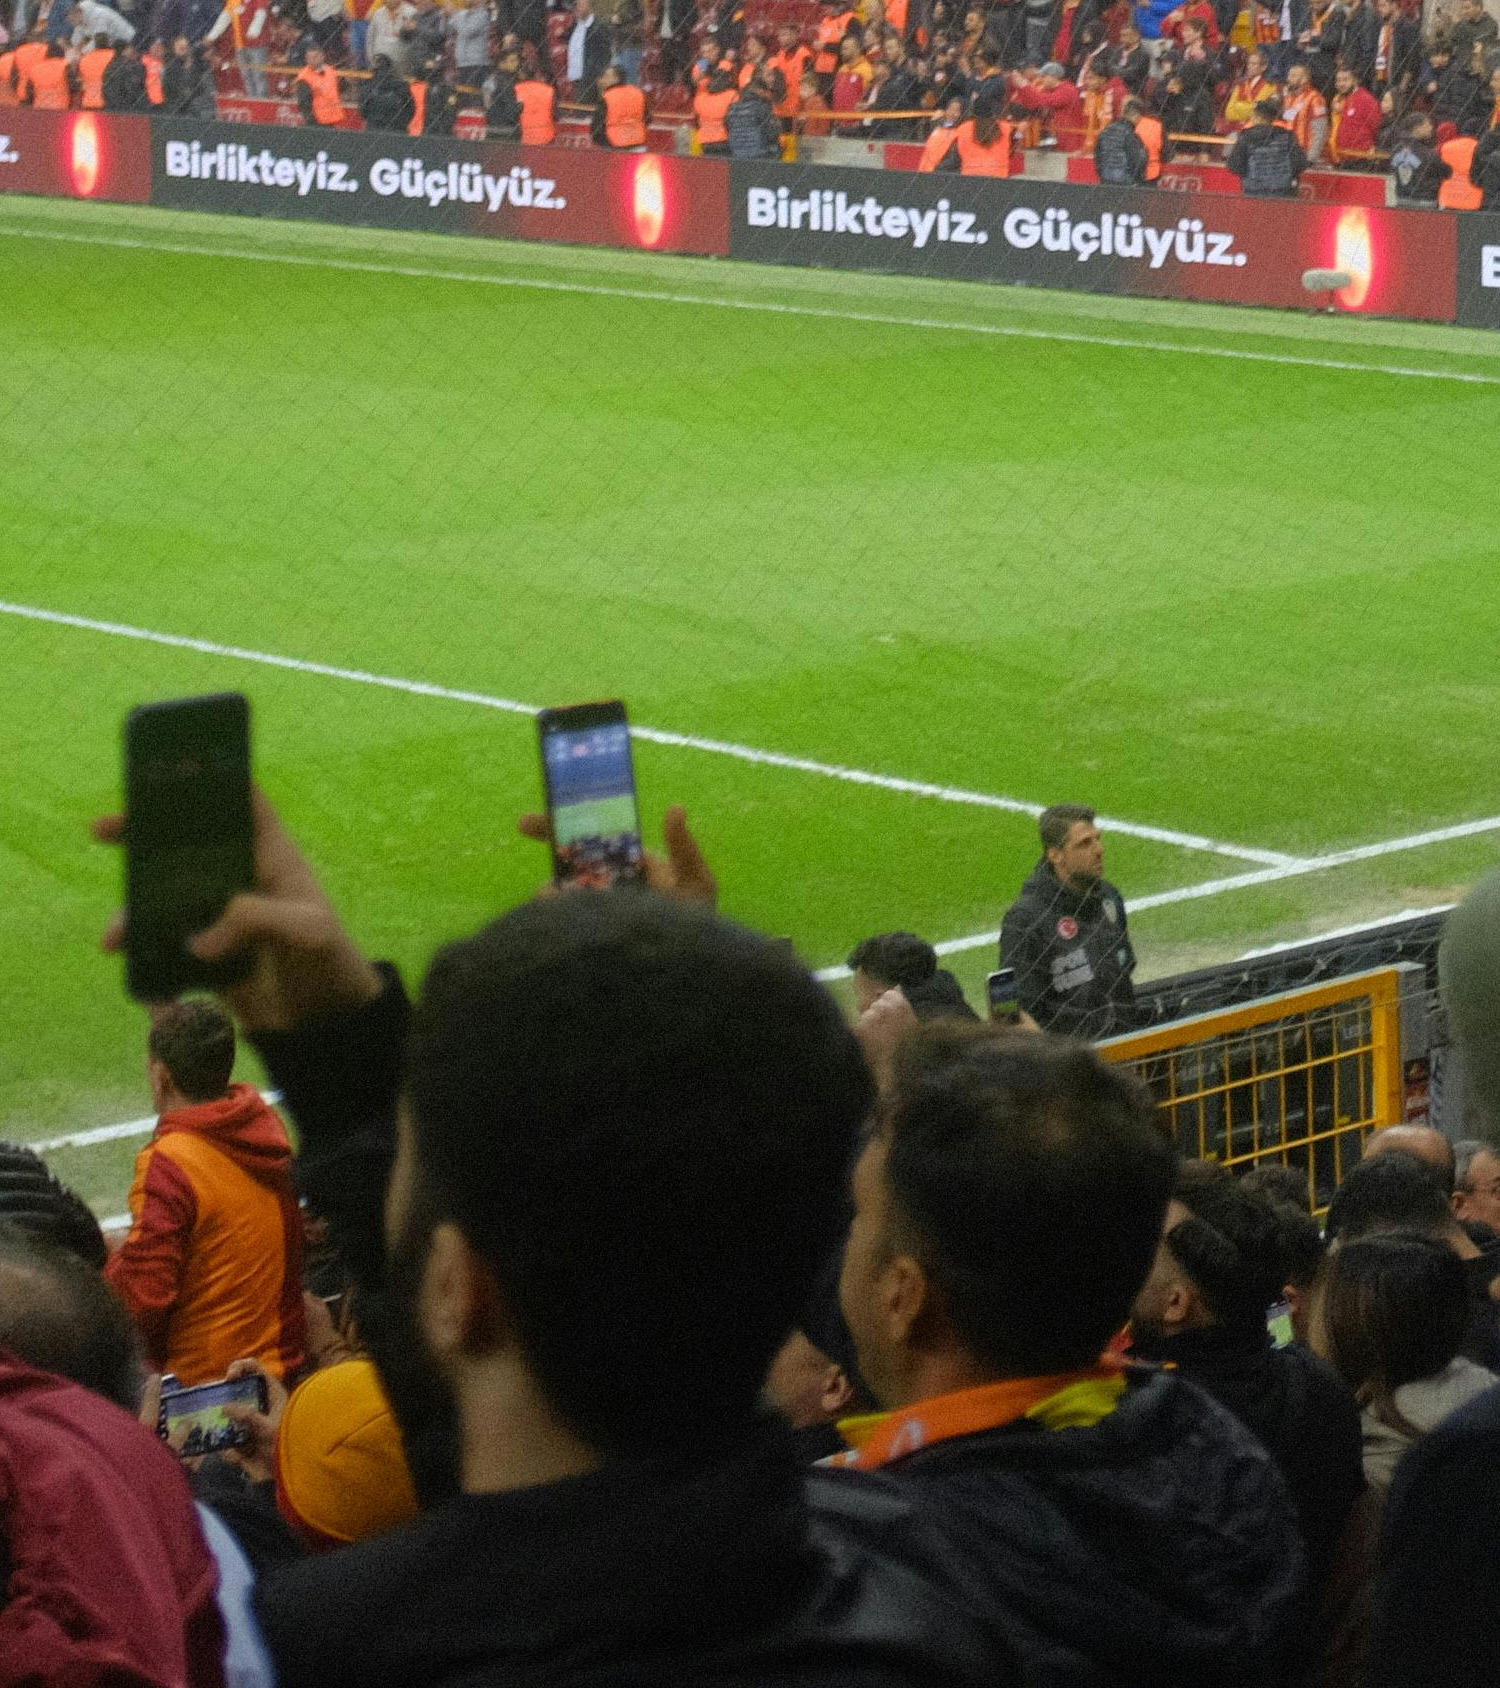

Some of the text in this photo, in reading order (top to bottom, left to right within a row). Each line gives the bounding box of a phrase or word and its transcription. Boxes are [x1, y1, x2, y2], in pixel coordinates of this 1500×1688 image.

[164, 139, 566, 211] Birlikteyiz. Güçlüyüz.
[748, 186, 1248, 269] Birlikteyiz. Güçlüyüz.
